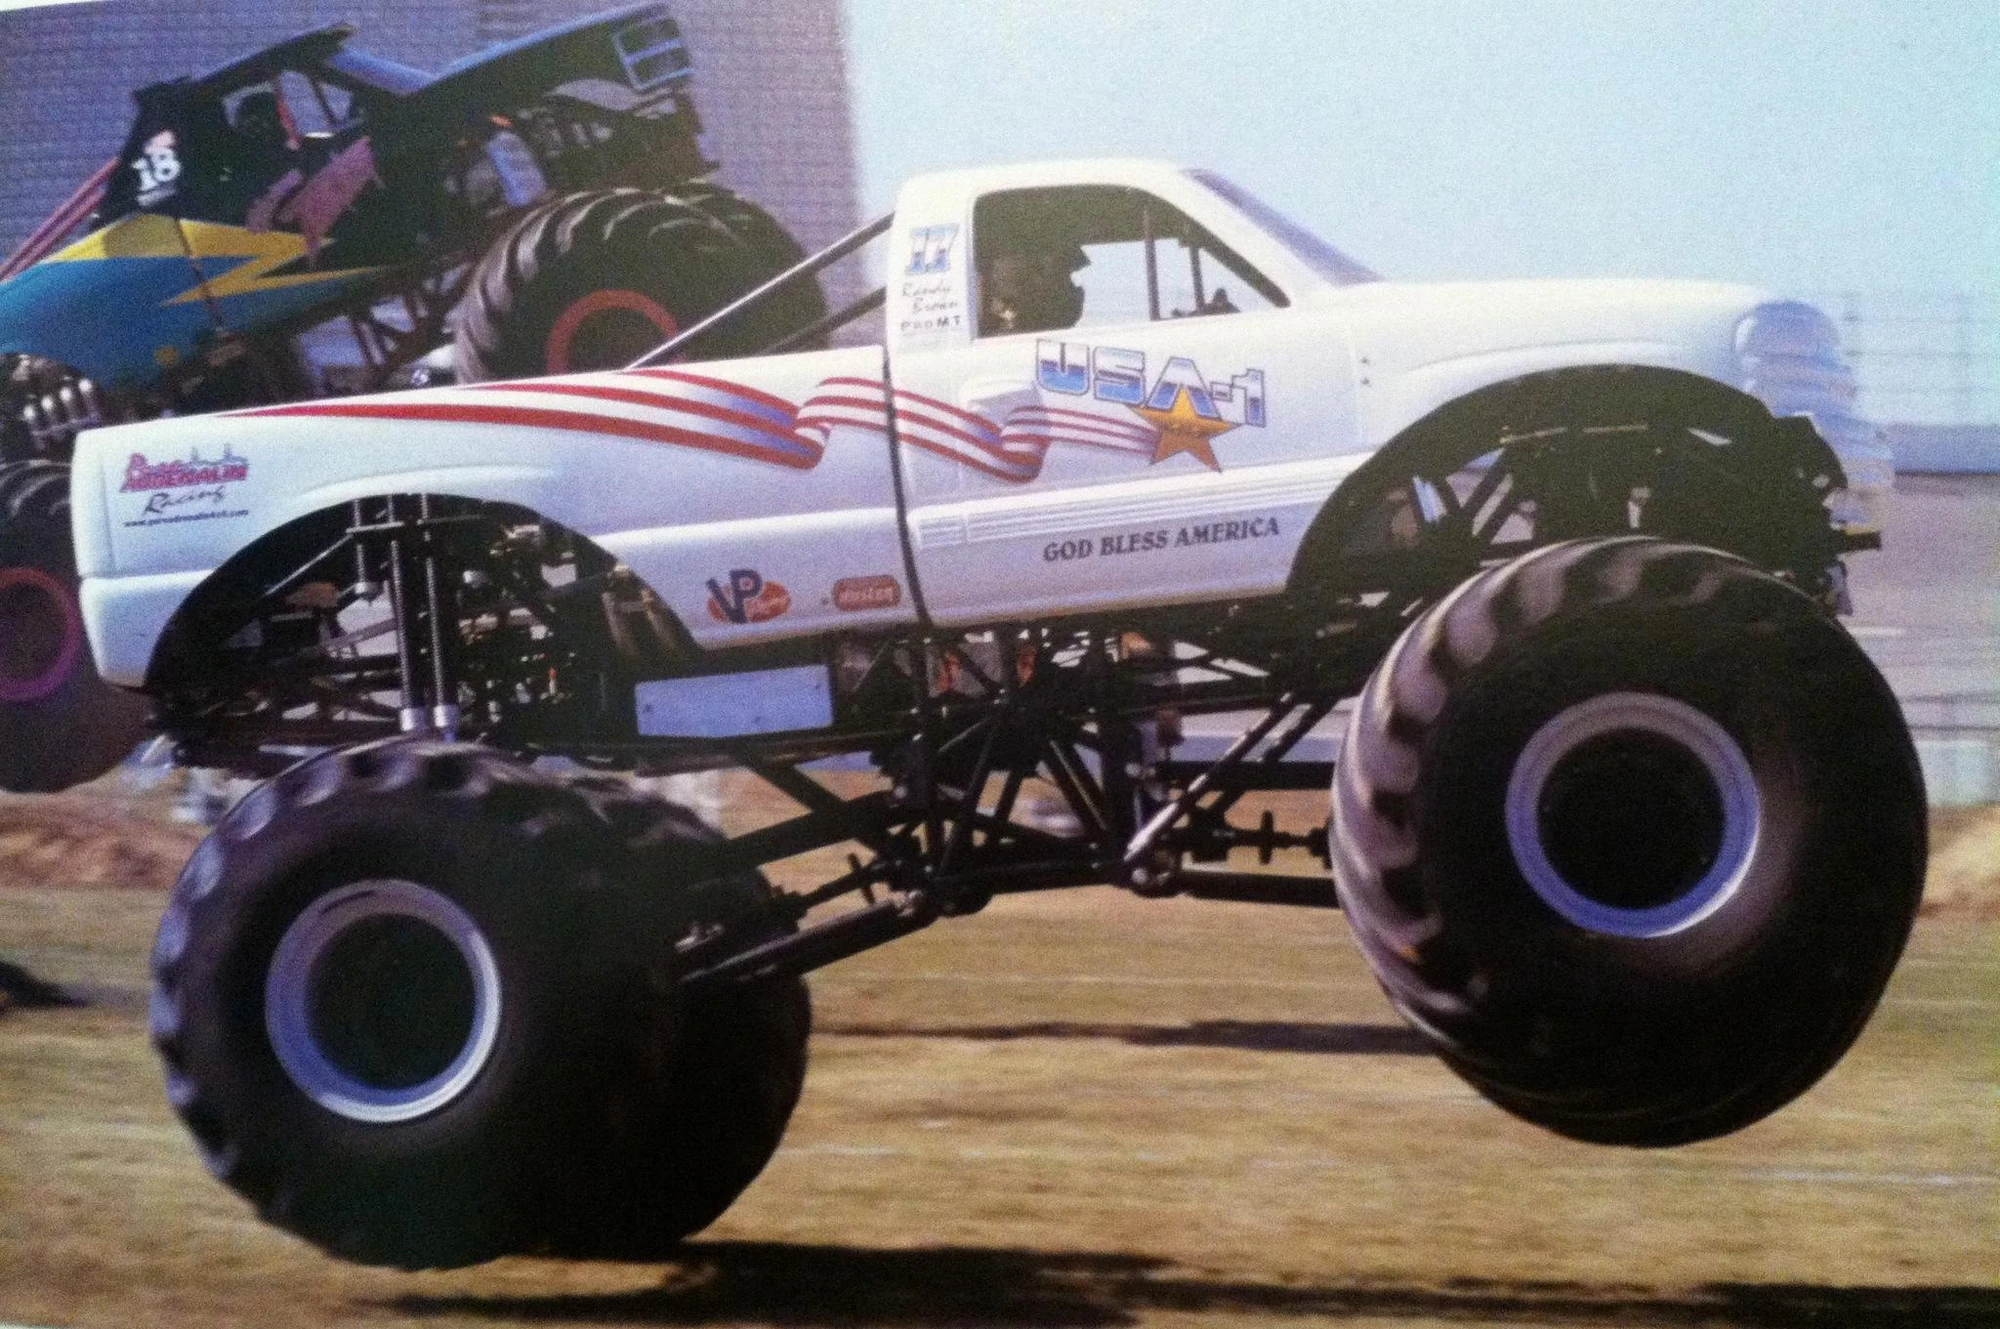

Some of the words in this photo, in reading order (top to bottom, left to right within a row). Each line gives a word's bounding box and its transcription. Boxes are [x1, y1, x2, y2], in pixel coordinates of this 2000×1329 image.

[1036, 338, 1266, 428] USA-1
[143, 485, 225, 516] Racing
[1043, 538, 1093, 563] GOD
[1100, 529, 1169, 557] BLESS
[1174, 516, 1280, 548] AMERICA
[706, 568, 763, 624] VP
